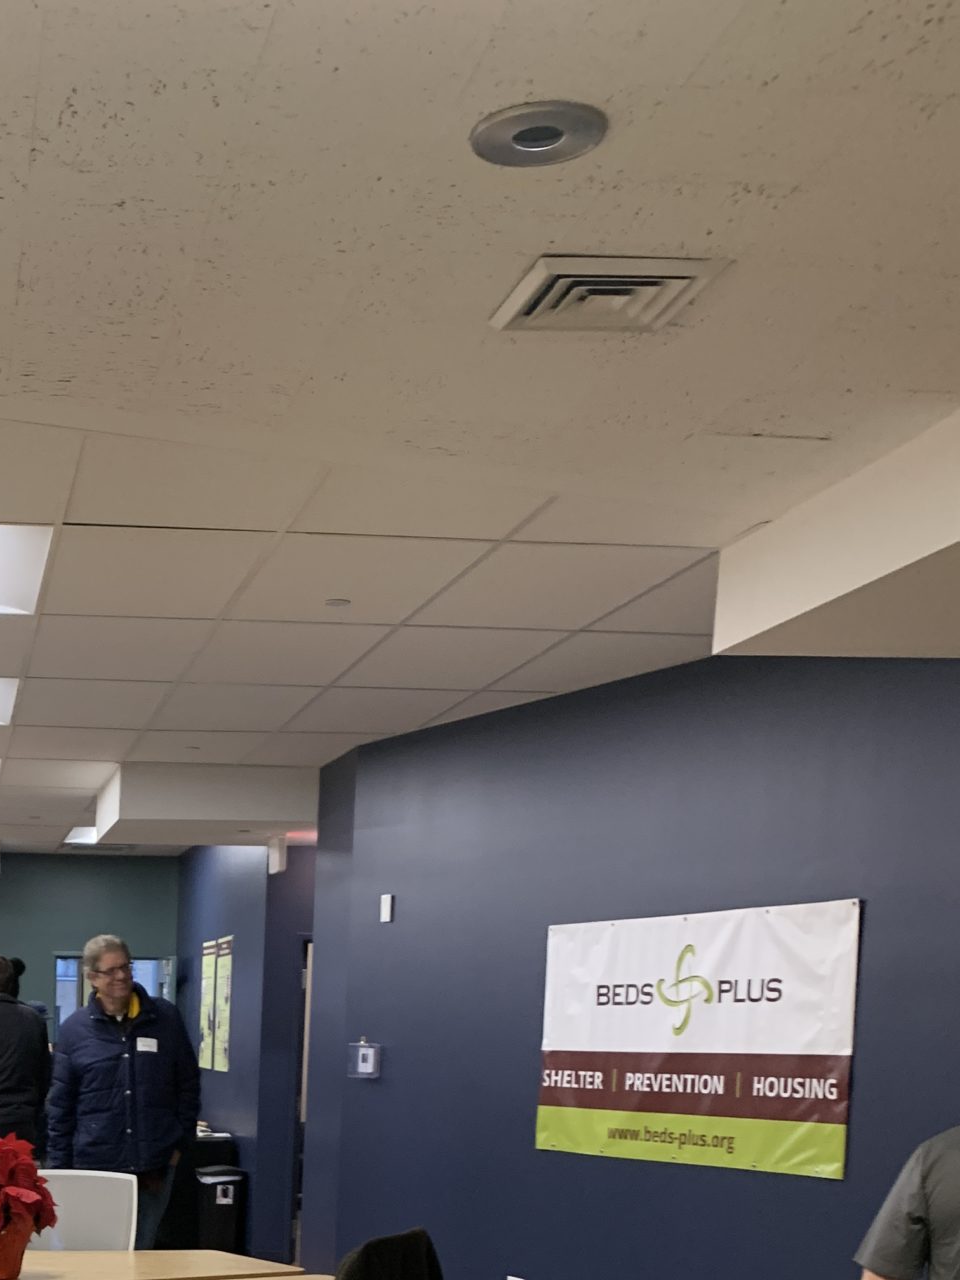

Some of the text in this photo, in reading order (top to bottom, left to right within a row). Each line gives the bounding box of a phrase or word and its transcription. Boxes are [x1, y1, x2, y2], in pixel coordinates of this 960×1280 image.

[596, 978, 783, 1006] BEDS PLUS
[542, 1070, 838, 1100] SHELTER PREVENTION HOUSING
[607, 1127, 735, 1154] www.beds-plus.org
